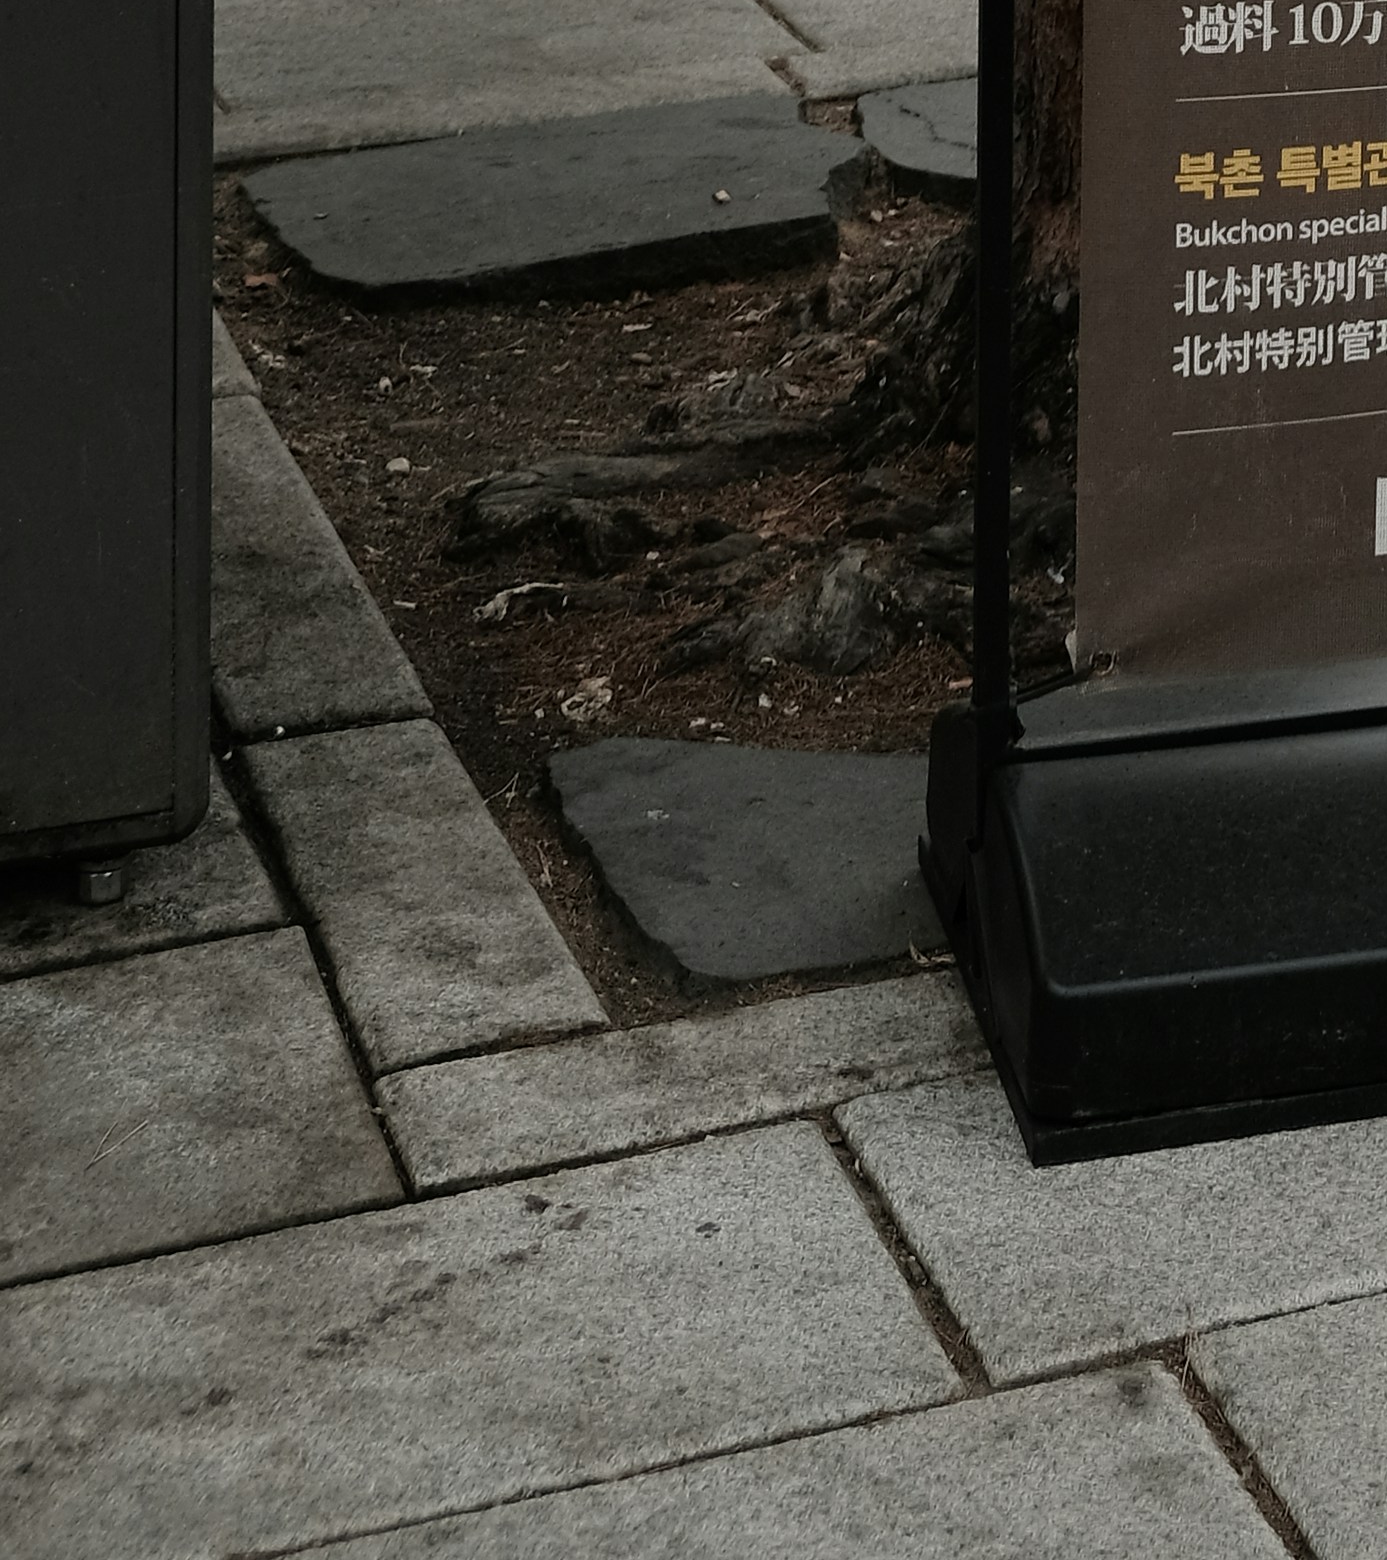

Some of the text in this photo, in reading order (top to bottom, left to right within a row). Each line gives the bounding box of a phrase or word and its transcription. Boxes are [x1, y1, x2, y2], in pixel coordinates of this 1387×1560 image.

[1175, 149, 1264, 199] 북촌
[1176, 218, 1292, 248] Bukchon
[1299, 206, 1387, 244] special
